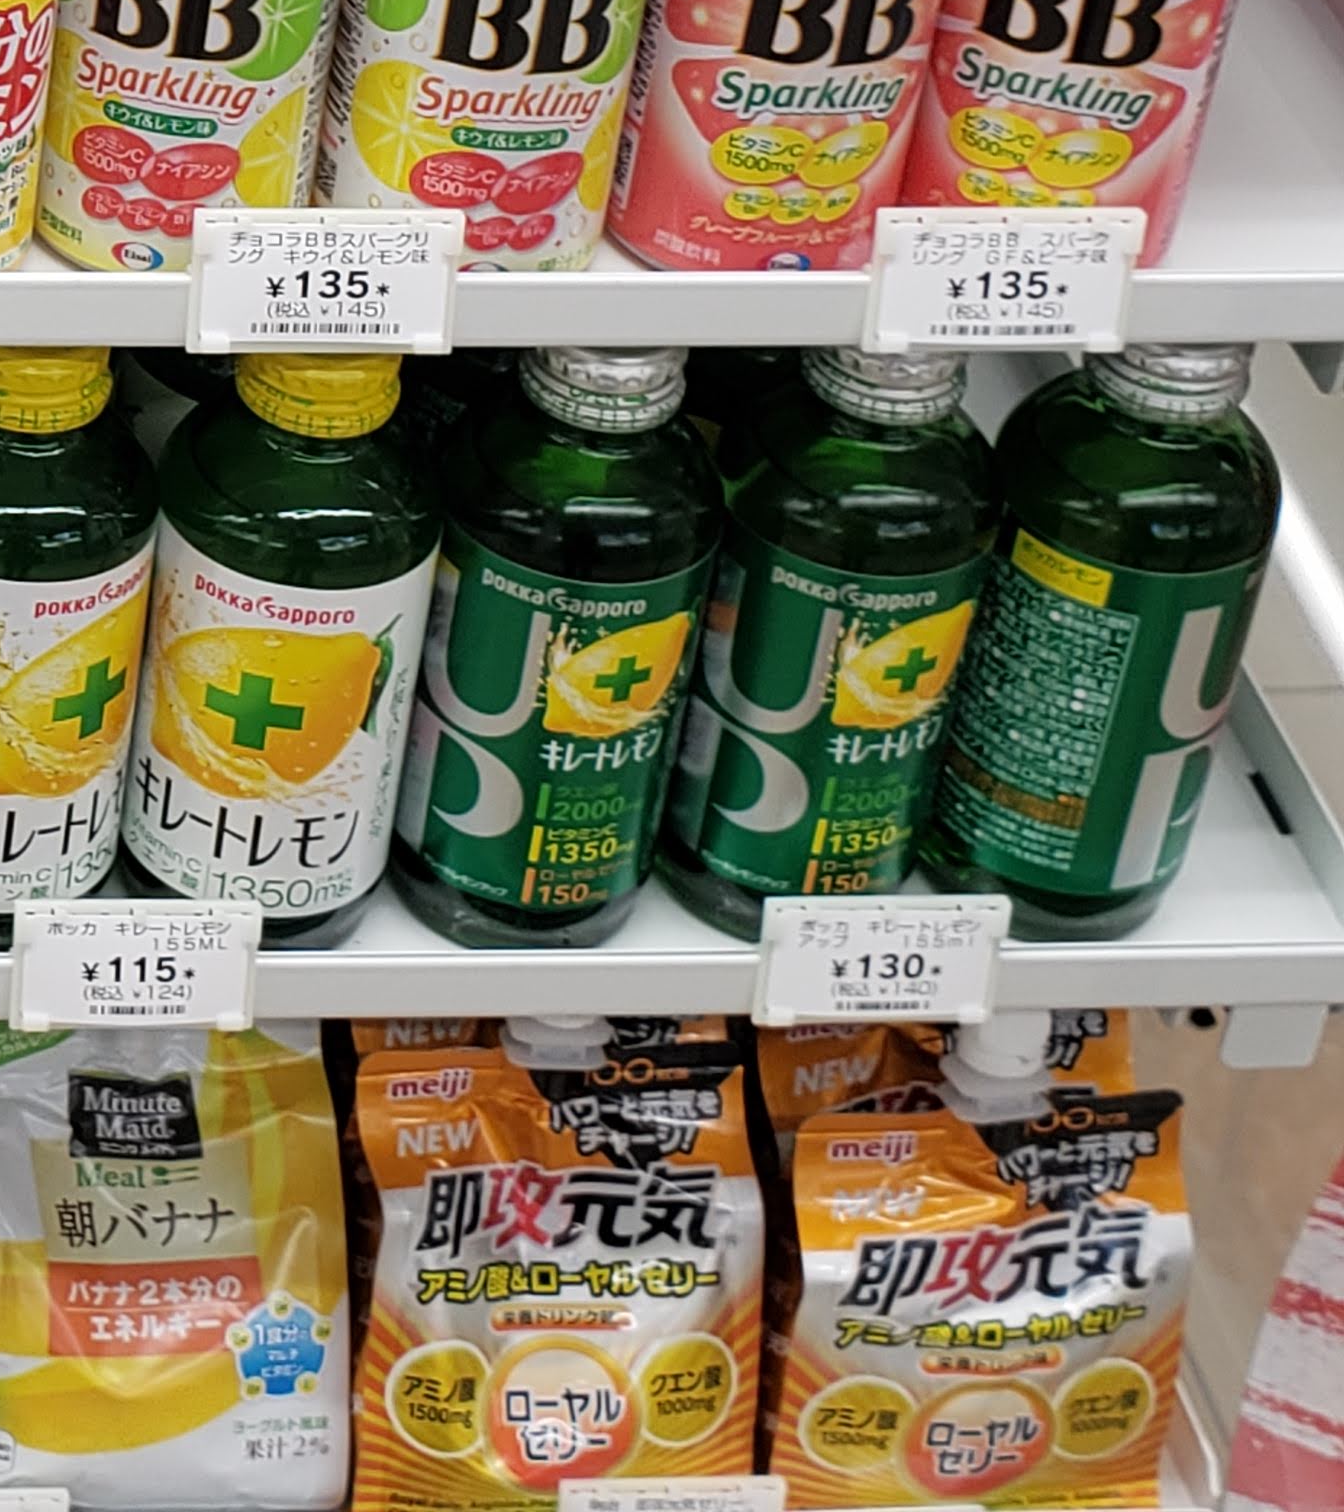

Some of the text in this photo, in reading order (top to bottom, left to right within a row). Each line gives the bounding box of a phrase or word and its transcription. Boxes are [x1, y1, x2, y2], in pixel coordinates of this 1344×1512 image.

[79, 48, 257, 118] Sparkling
[418, 76, 603, 121] Sparkling
[717, 72, 904, 113] Sparkling
[957, 48, 1153, 122] Sparkling
[391, 1069, 470, 1097] meiji
[398, 1120, 479, 1155] NEW
[57, 1198, 234, 1248] 朝バナナ
[419, 1159, 717, 1259] 即攻元気
[839, 1209, 1151, 1315] 即攻元気
